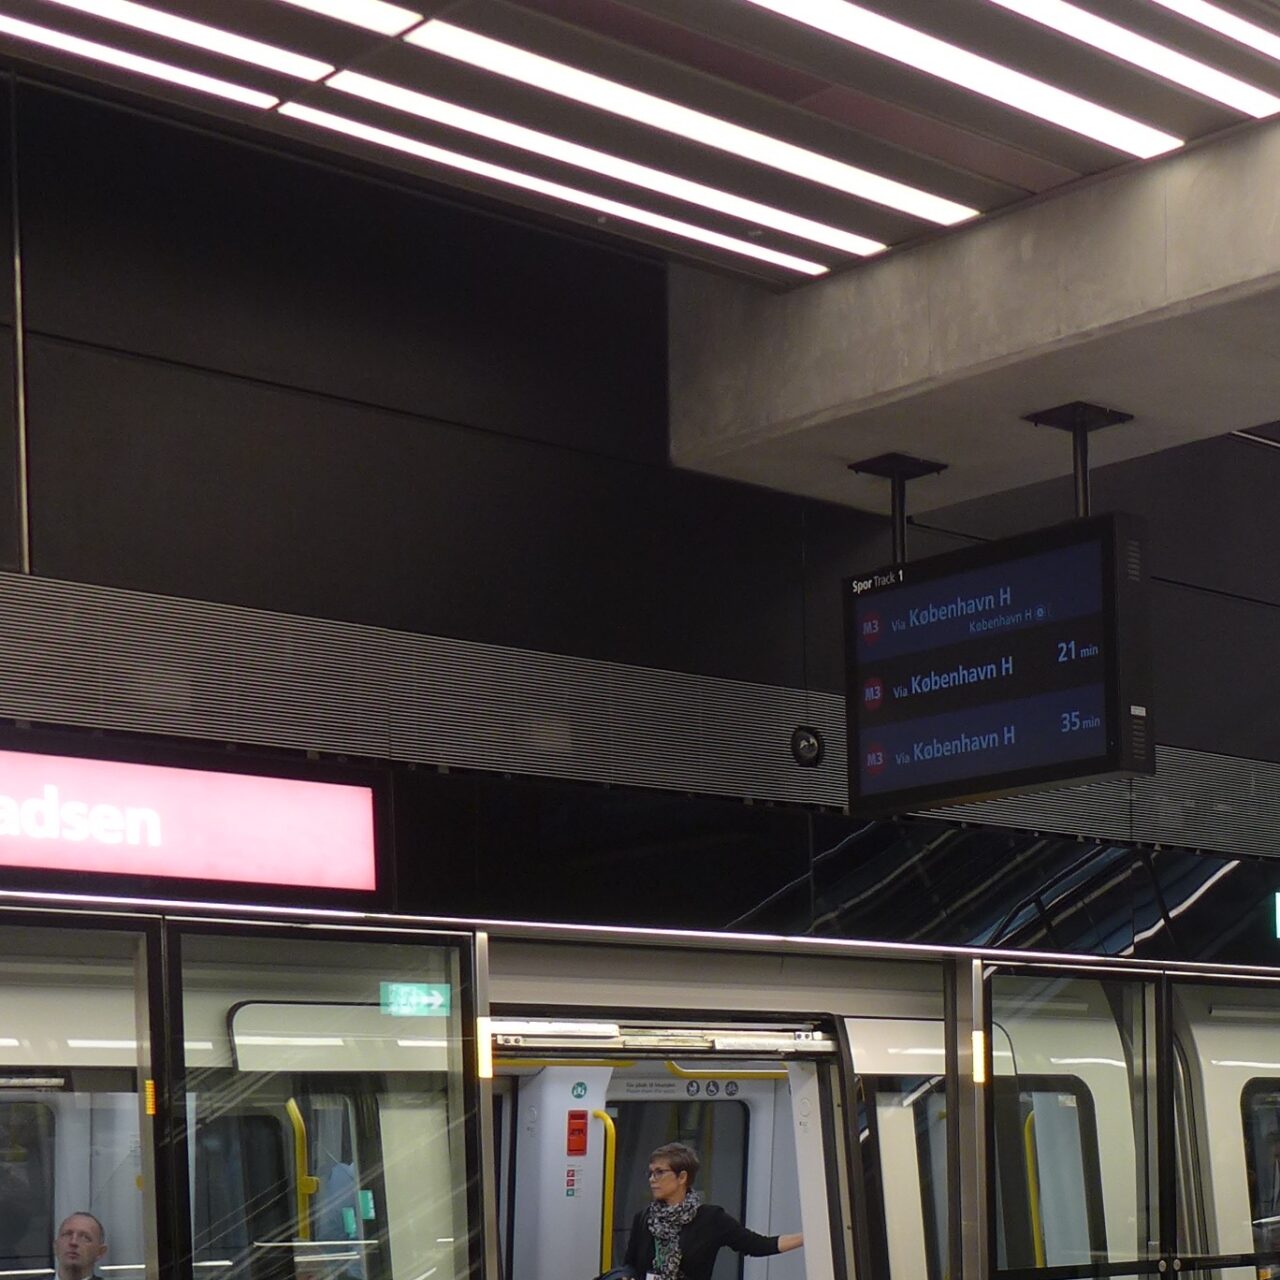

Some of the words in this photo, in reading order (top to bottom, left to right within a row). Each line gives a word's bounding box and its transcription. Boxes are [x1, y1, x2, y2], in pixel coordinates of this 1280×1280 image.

[852, 578, 873, 594] Spor
[874, 571, 895, 588] Track
[898, 569, 904, 582] 1
[891, 619, 906, 632] Via
[909, 595, 994, 627] København
[999, 586, 1012, 606] H
[969, 613, 1022, 633] København
[1024, 608, 1032, 620] H
[862, 619, 879, 635] M3
[1057, 640, 1076, 662] 21
[1080, 644, 1099, 658] min
[893, 686, 908, 699] Via
[911, 666, 996, 694] København
[1001, 656, 1014, 675] H
[864, 686, 881, 701] M3
[1061, 711, 1080, 733] 35
[1082, 716, 1101, 729] min
[895, 752, 910, 765] Via
[913, 733, 999, 761] København
[1003, 726, 1016, 745] H
[866, 752, 883, 767] M3
[0, 784, 162, 846] adsen
